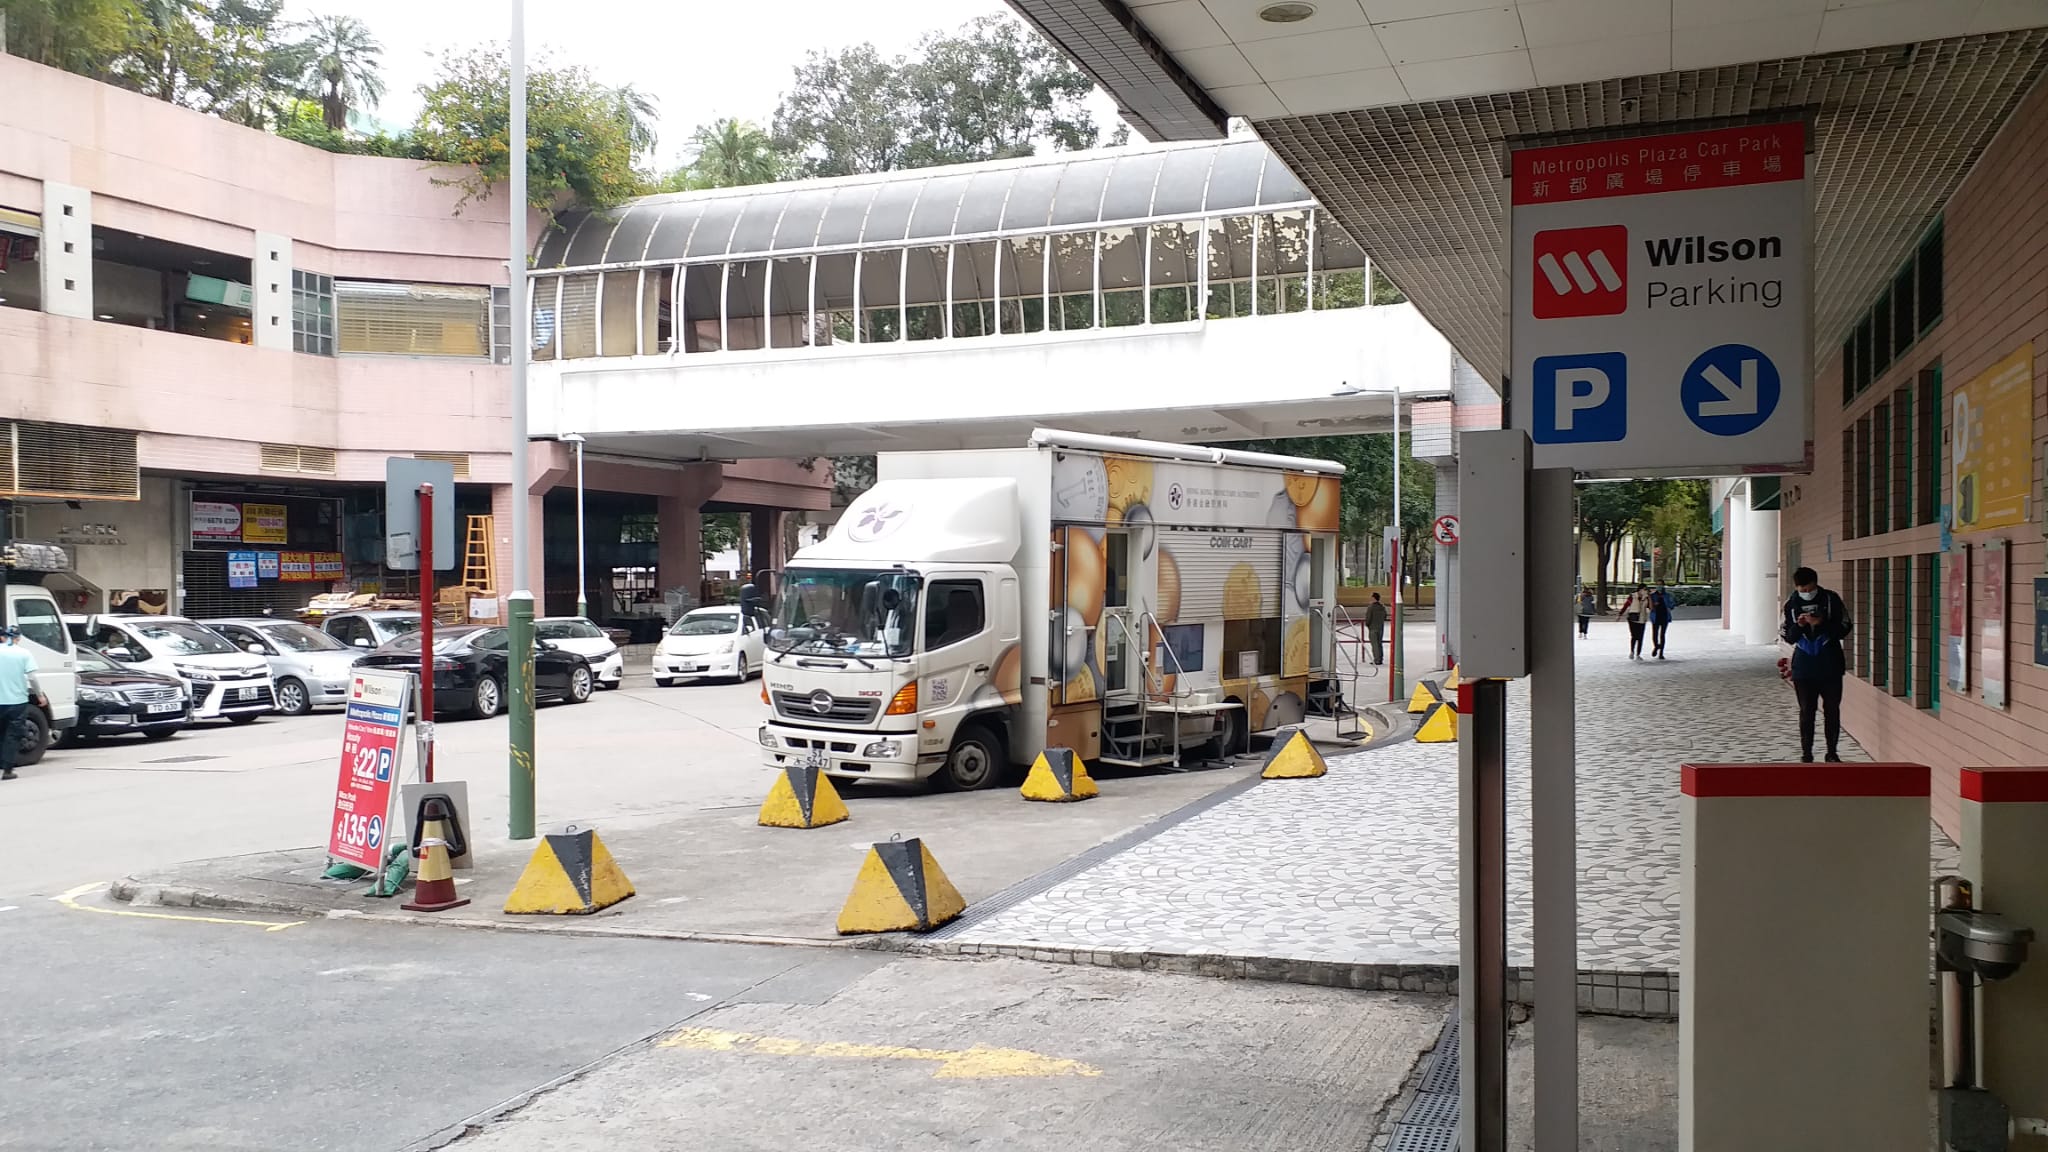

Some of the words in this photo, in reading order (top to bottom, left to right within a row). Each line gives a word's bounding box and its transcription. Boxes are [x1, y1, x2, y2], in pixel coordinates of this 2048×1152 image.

[1532, 152, 1630, 176] Metropolis
[1639, 147, 1688, 165] Plaza
[1698, 142, 1729, 158] Car
[1740, 134, 1782, 151] Park
[1532, 155, 1783, 198] 新都廣場停車場
[1645, 235, 1782, 267] Wilson
[1648, 276, 1783, 309] Parking
[1555, 367, 1610, 431] P
[1232, 536, 1252, 549] CART
[353, 747, 377, 779] $22
[379, 752, 390, 775] P
[337, 812, 367, 846] $135
